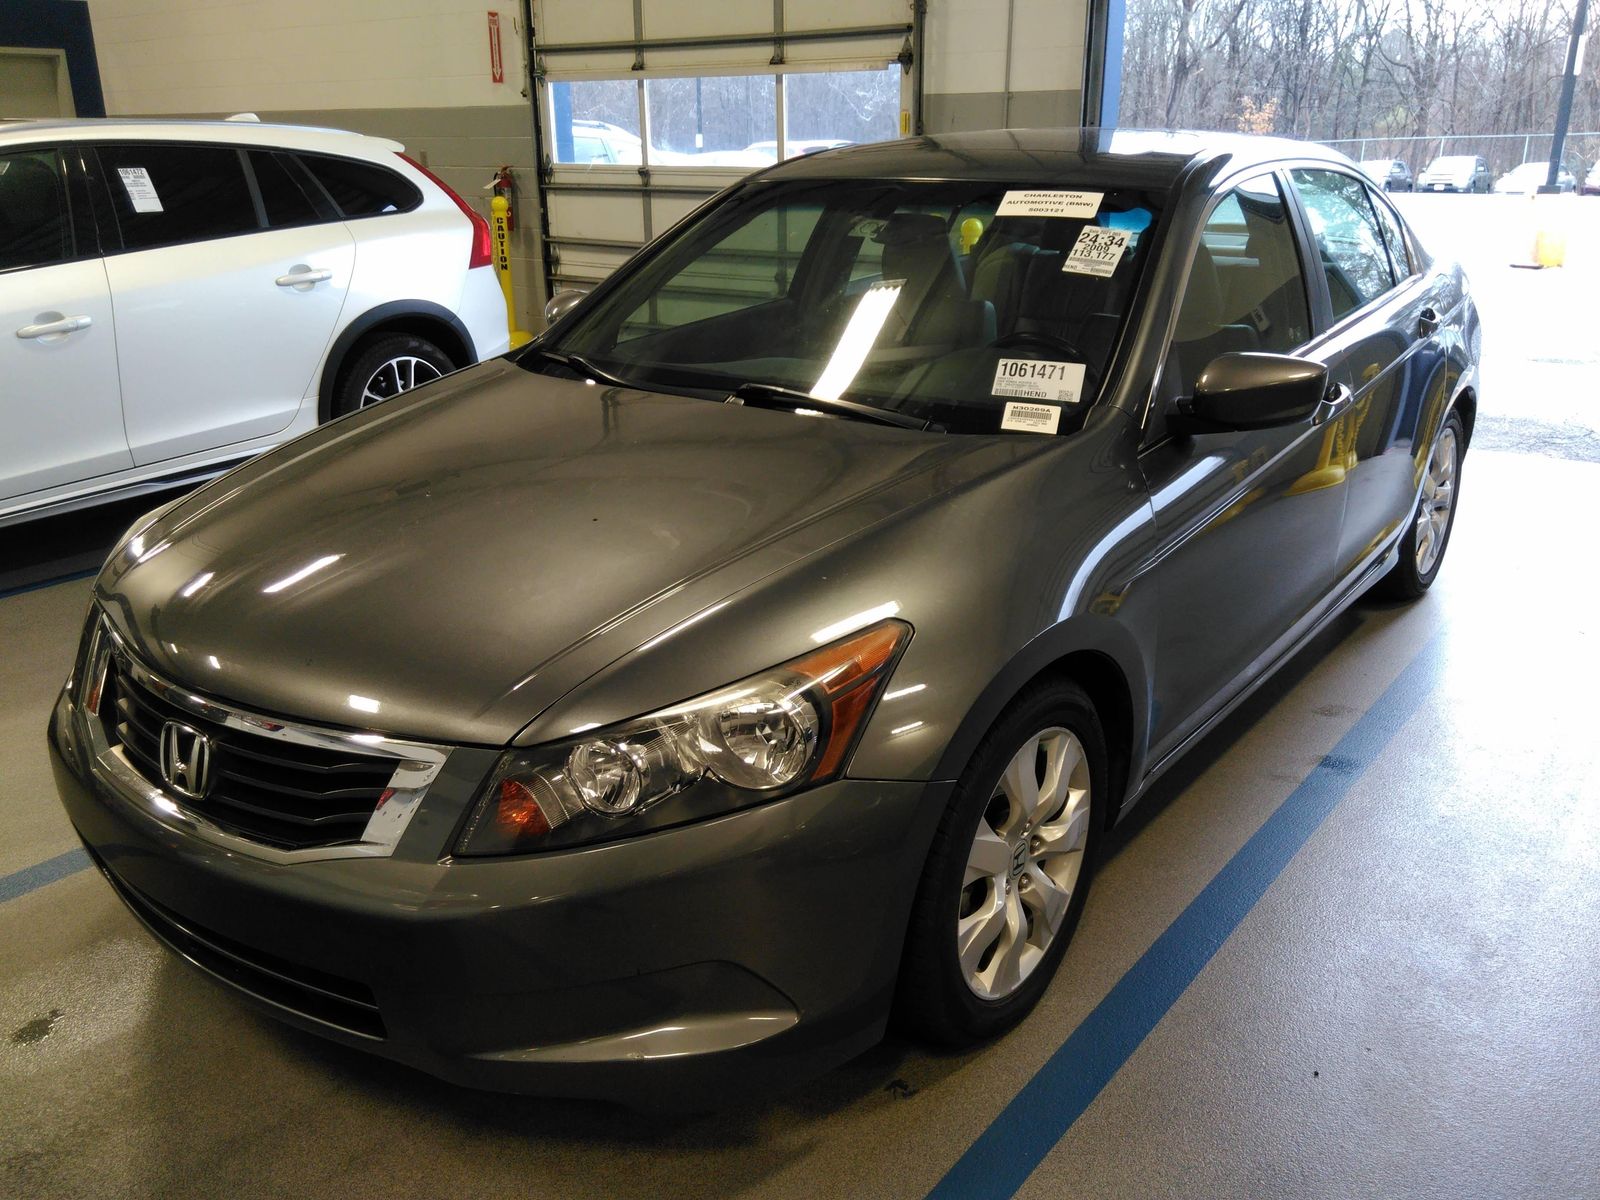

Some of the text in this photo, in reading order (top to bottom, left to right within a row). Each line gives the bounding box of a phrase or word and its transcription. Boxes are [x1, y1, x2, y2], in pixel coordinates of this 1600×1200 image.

[496, 217, 508, 271] CAUTION
[1078, 232, 1126, 248] 24:34
[1083, 243, 1110, 253] 2009
[1001, 362, 1066, 381] 1061471
[1023, 390, 1047, 398] HEND
